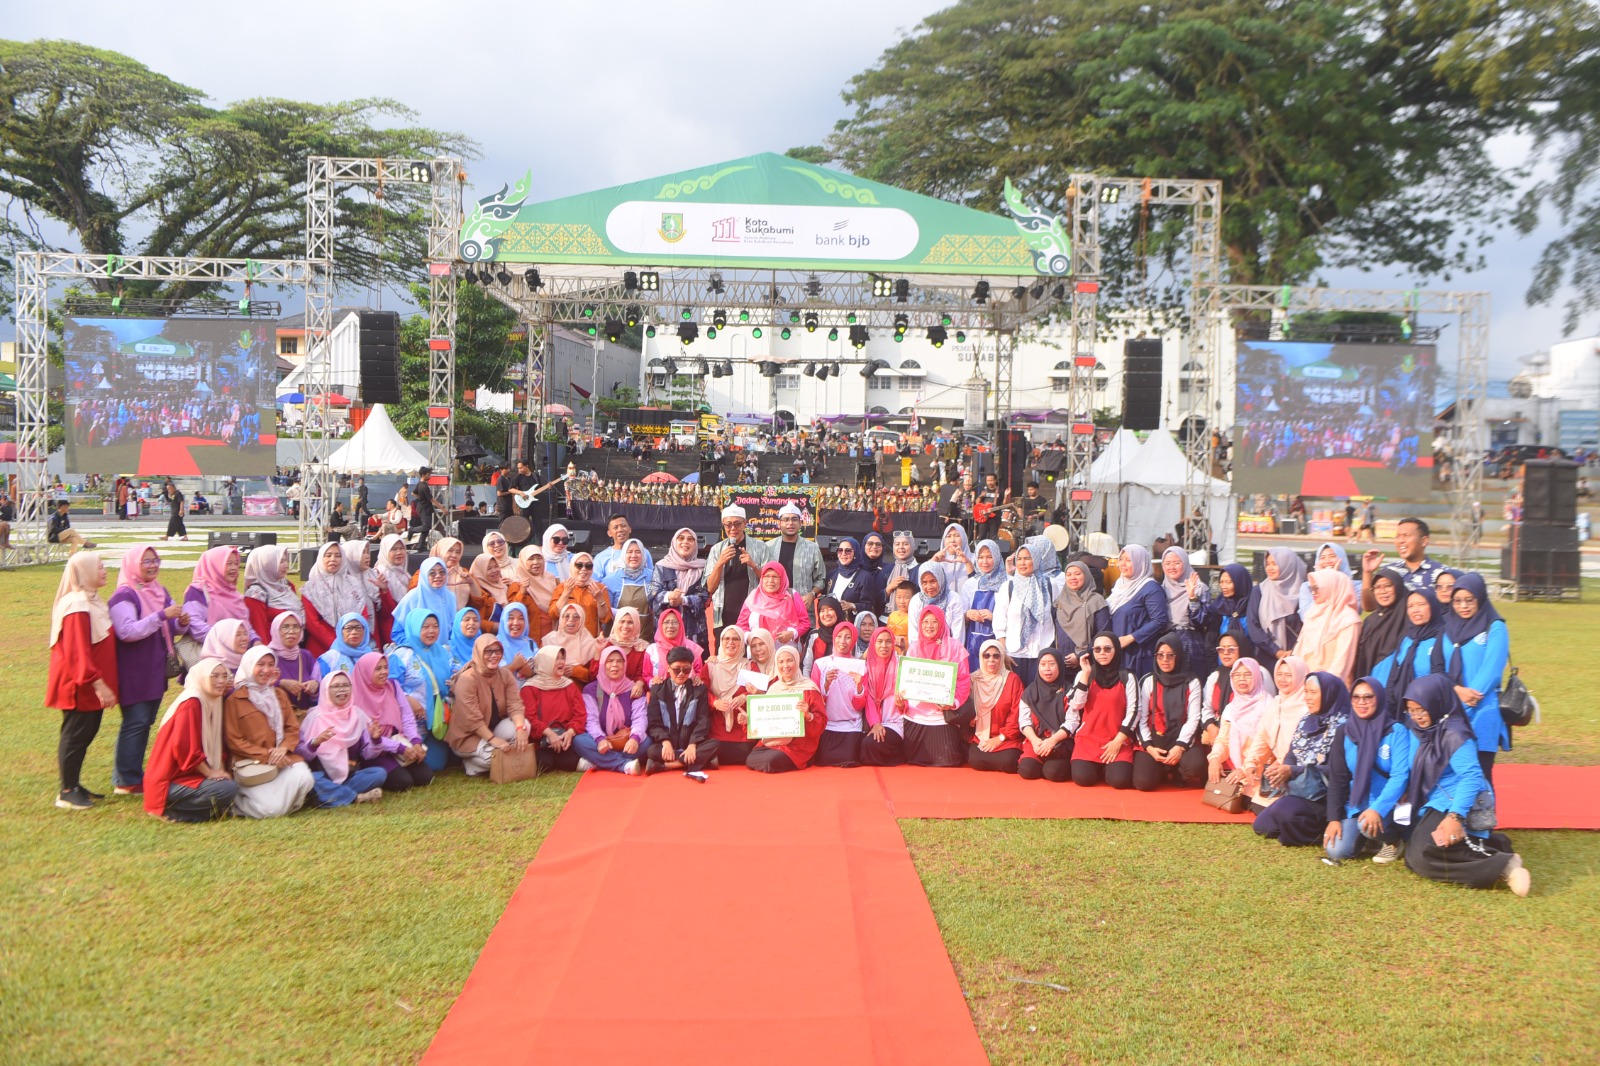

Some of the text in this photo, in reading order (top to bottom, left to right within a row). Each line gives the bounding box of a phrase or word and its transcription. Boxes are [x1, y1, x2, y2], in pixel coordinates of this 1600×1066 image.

[745, 217, 768, 226] Kota
[745, 226, 794, 235] Sukabumi
[815, 234, 871, 249] bank bjb
